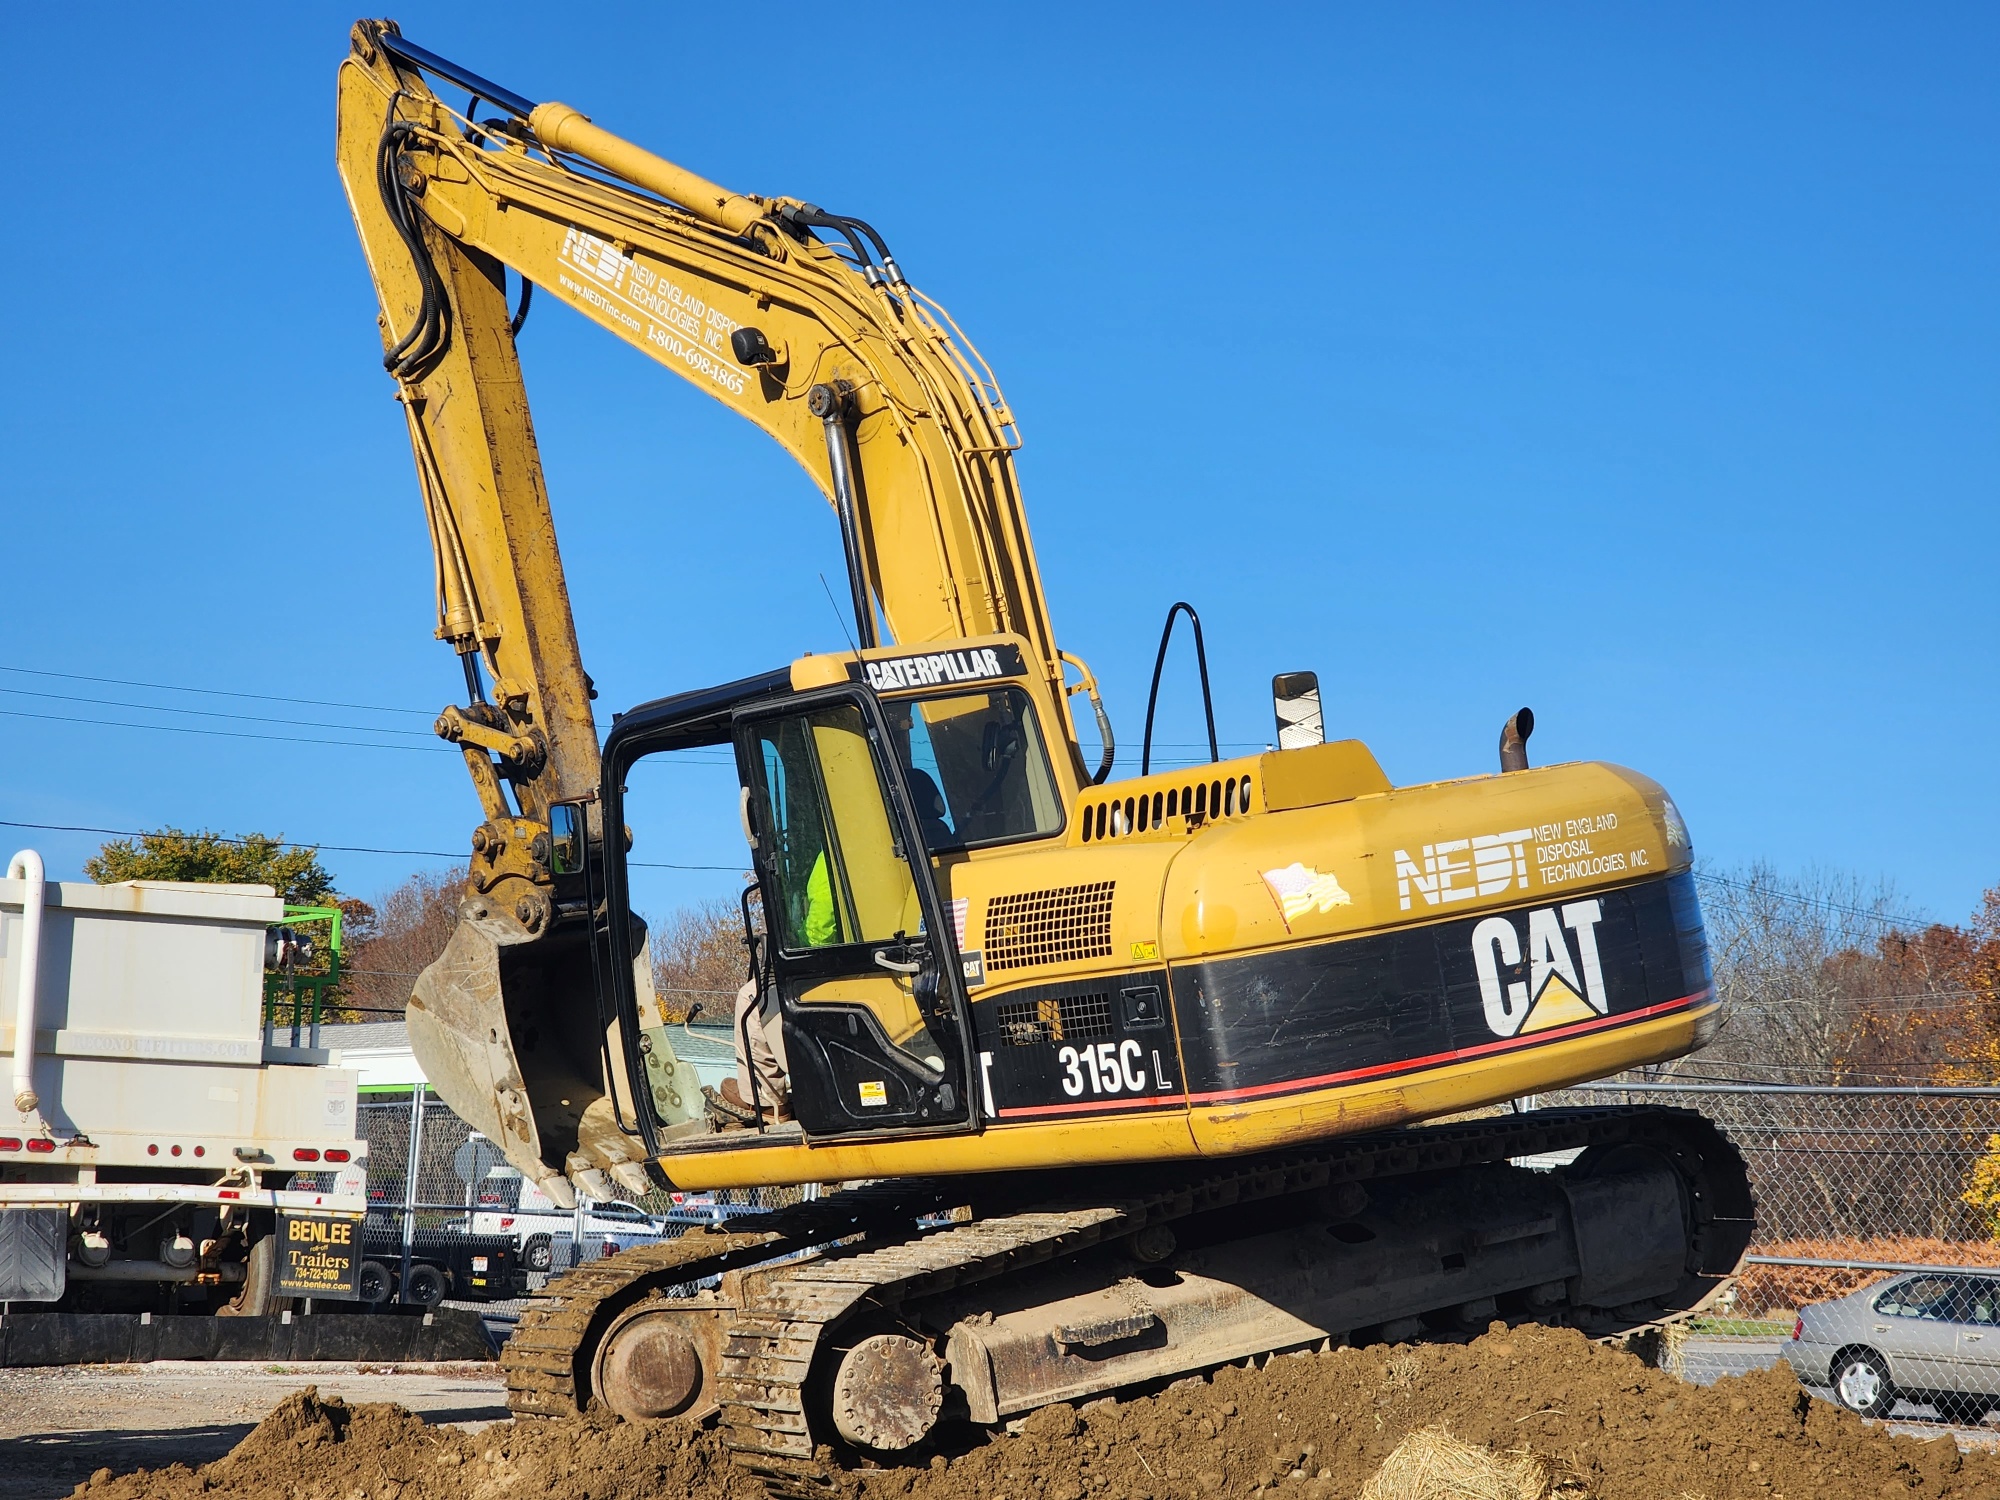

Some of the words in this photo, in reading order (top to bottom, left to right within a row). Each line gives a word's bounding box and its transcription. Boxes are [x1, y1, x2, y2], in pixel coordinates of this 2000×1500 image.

[562, 223, 635, 289] NEDT
[559, 273, 641, 332] www.NEDTinc.com
[628, 280, 701, 341] TECHNOLOGIES,
[704, 327, 723, 352] INC.
[631, 262, 657, 289] NEW
[658, 279, 705, 317] ENGLAND
[706, 307, 744, 338] DISPO
[646, 323, 744, 396] 1-800-698-1865
[866, 649, 1003, 690] CATERPILLAR
[1533, 822, 1562, 843] NEW
[1566, 813, 1618, 837] ENGLAND
[1394, 828, 1533, 911] NEDT
[1536, 839, 1594, 864] DISPOSAL
[1539, 854, 1628, 885] TECHNOLOGIES,
[1631, 849, 1650, 868] INC.
[963, 960, 981, 978] CAT
[1471, 899, 1609, 1037] CAT
[1058, 1039, 1146, 1096] 315C
[1152, 1050, 1173, 1090] L
[289, 1220, 352, 1245] BENLEE
[288, 1250, 350, 1269] Trailers
[295, 1267, 339, 1281] 734-722-8100
[280, 1280, 351, 1290] www.benlee.com
